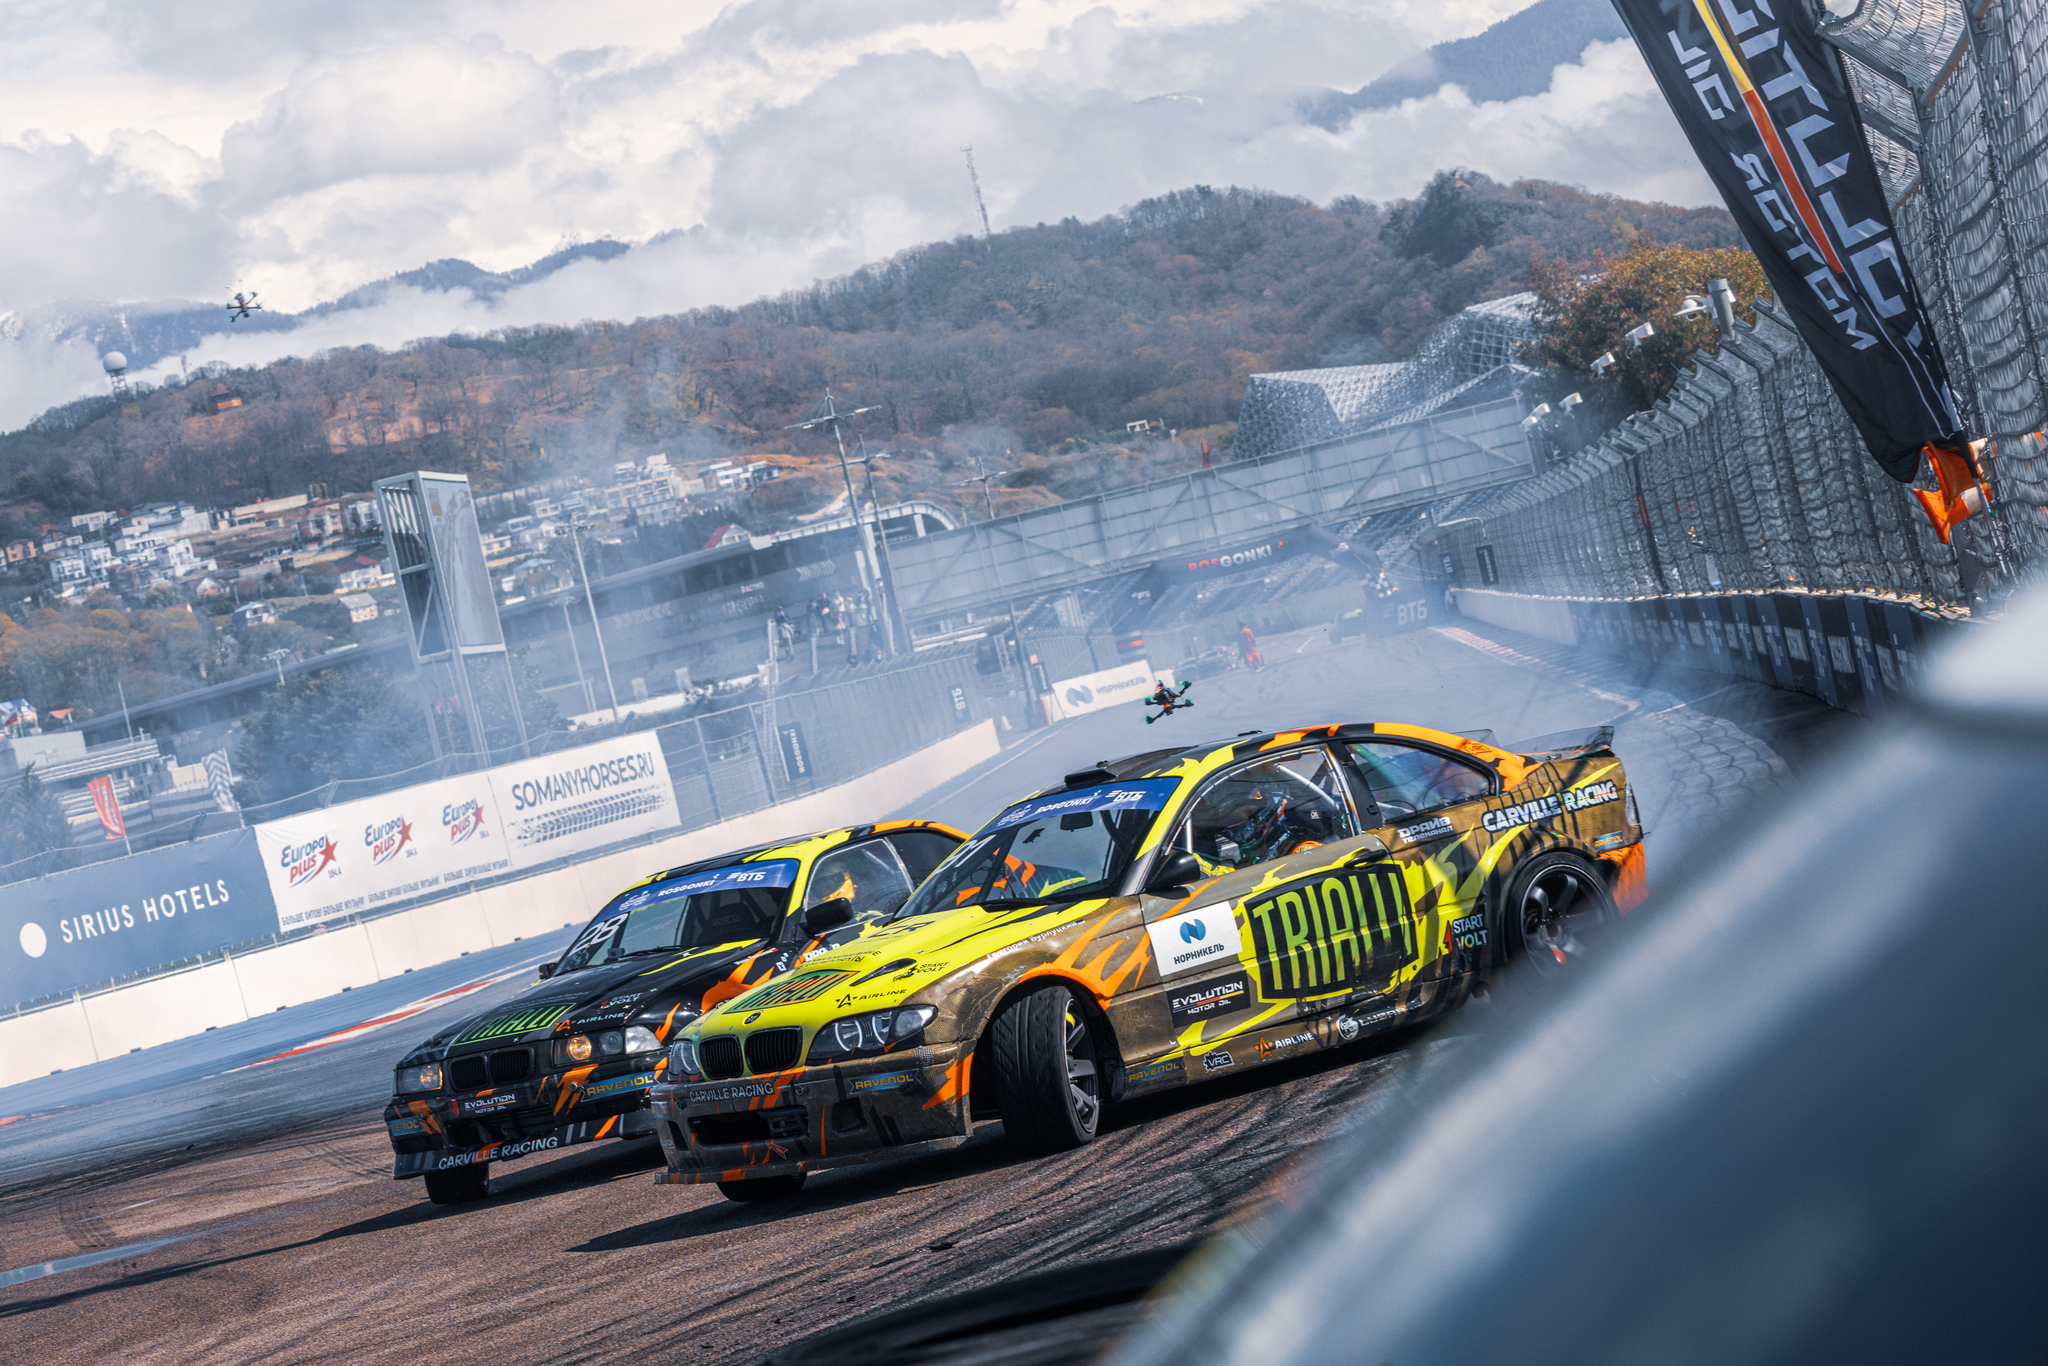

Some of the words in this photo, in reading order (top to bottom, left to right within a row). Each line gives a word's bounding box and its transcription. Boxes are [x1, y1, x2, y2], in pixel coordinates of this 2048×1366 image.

[1187, 545, 1272, 571] ROSGONKI
[1397, 599, 1428, 625] ВТБ
[1096, 676, 1147, 694] НОРНИКЕЛЬ
[512, 752, 654, 811] SOMANYHORSES.RU
[1035, 797, 1093, 814] ROSGONKI
[1113, 791, 1147, 802] ВТБ
[1482, 796, 1562, 832] CARVILLE
[1565, 781, 1619, 811] RACING
[1397, 816, 1451, 838] ДРАЙВ
[736, 871, 767, 882] ВТБ
[658, 880, 715, 897] ROSGONKI
[60, 904, 134, 943] SIRIUS
[142, 879, 229, 922] HOTELS
[1453, 914, 1484, 934] START
[568, 913, 629, 955] 28
[1456, 929, 1488, 949] VOLT
[1174, 943, 1225, 965] НОРНИКЕЛЬ
[609, 996, 640, 1006] VOLT
[612, 992, 643, 1001] START
[859, 989, 907, 1000] AIRLINE
[1172, 981, 1243, 1008] EVOLUTION
[576, 1011, 625, 1025] AIRLINE
[1188, 1003, 1215, 1014] MOTOR
[1275, 1032, 1315, 1049] AIRLINE
[1207, 1055, 1230, 1068] VRC
[854, 1074, 914, 1090] RAVENOL
[1129, 1062, 1180, 1083] RAVENOL
[586, 1074, 654, 1097] RAVENOL
[689, 1087, 729, 1103] CARVILLE
[731, 1082, 774, 1099] RACING
[464, 1093, 516, 1109] EVOLUTION
[475, 1106, 495, 1114] MOTOR
[496, 1104, 507, 1112] OIL
[438, 1145, 498, 1170] CARVILLE
[500, 1137, 558, 1157] RACING
